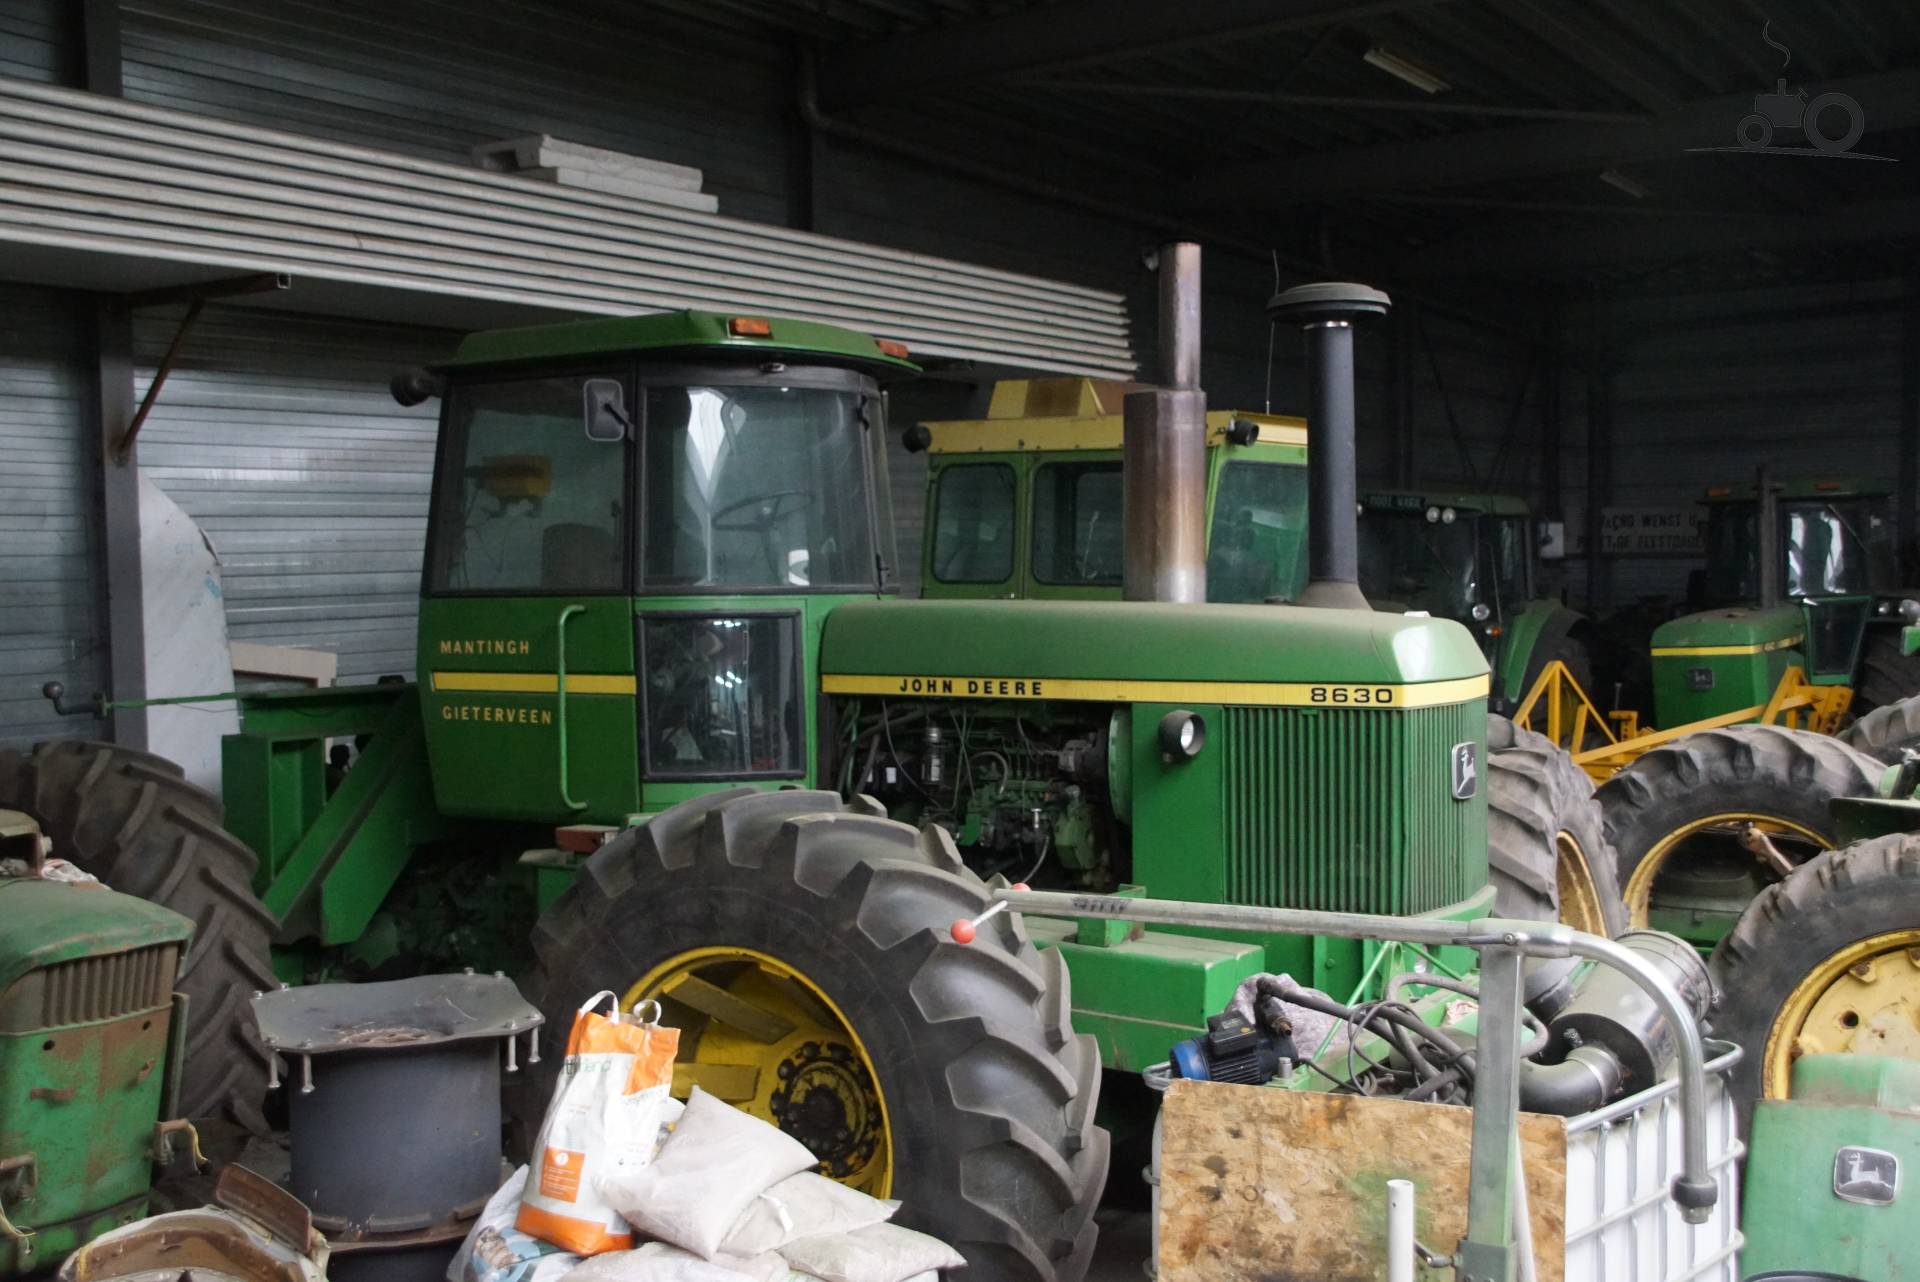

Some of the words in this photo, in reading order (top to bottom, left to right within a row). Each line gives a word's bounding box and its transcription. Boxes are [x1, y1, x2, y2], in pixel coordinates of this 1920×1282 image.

[439, 640, 530, 655] MANTINGH
[899, 678, 953, 694] JOHN
[967, 680, 1042, 696] DEERE
[1310, 687, 1393, 704] 8630
[441, 705, 552, 725] GIETERVEEN
